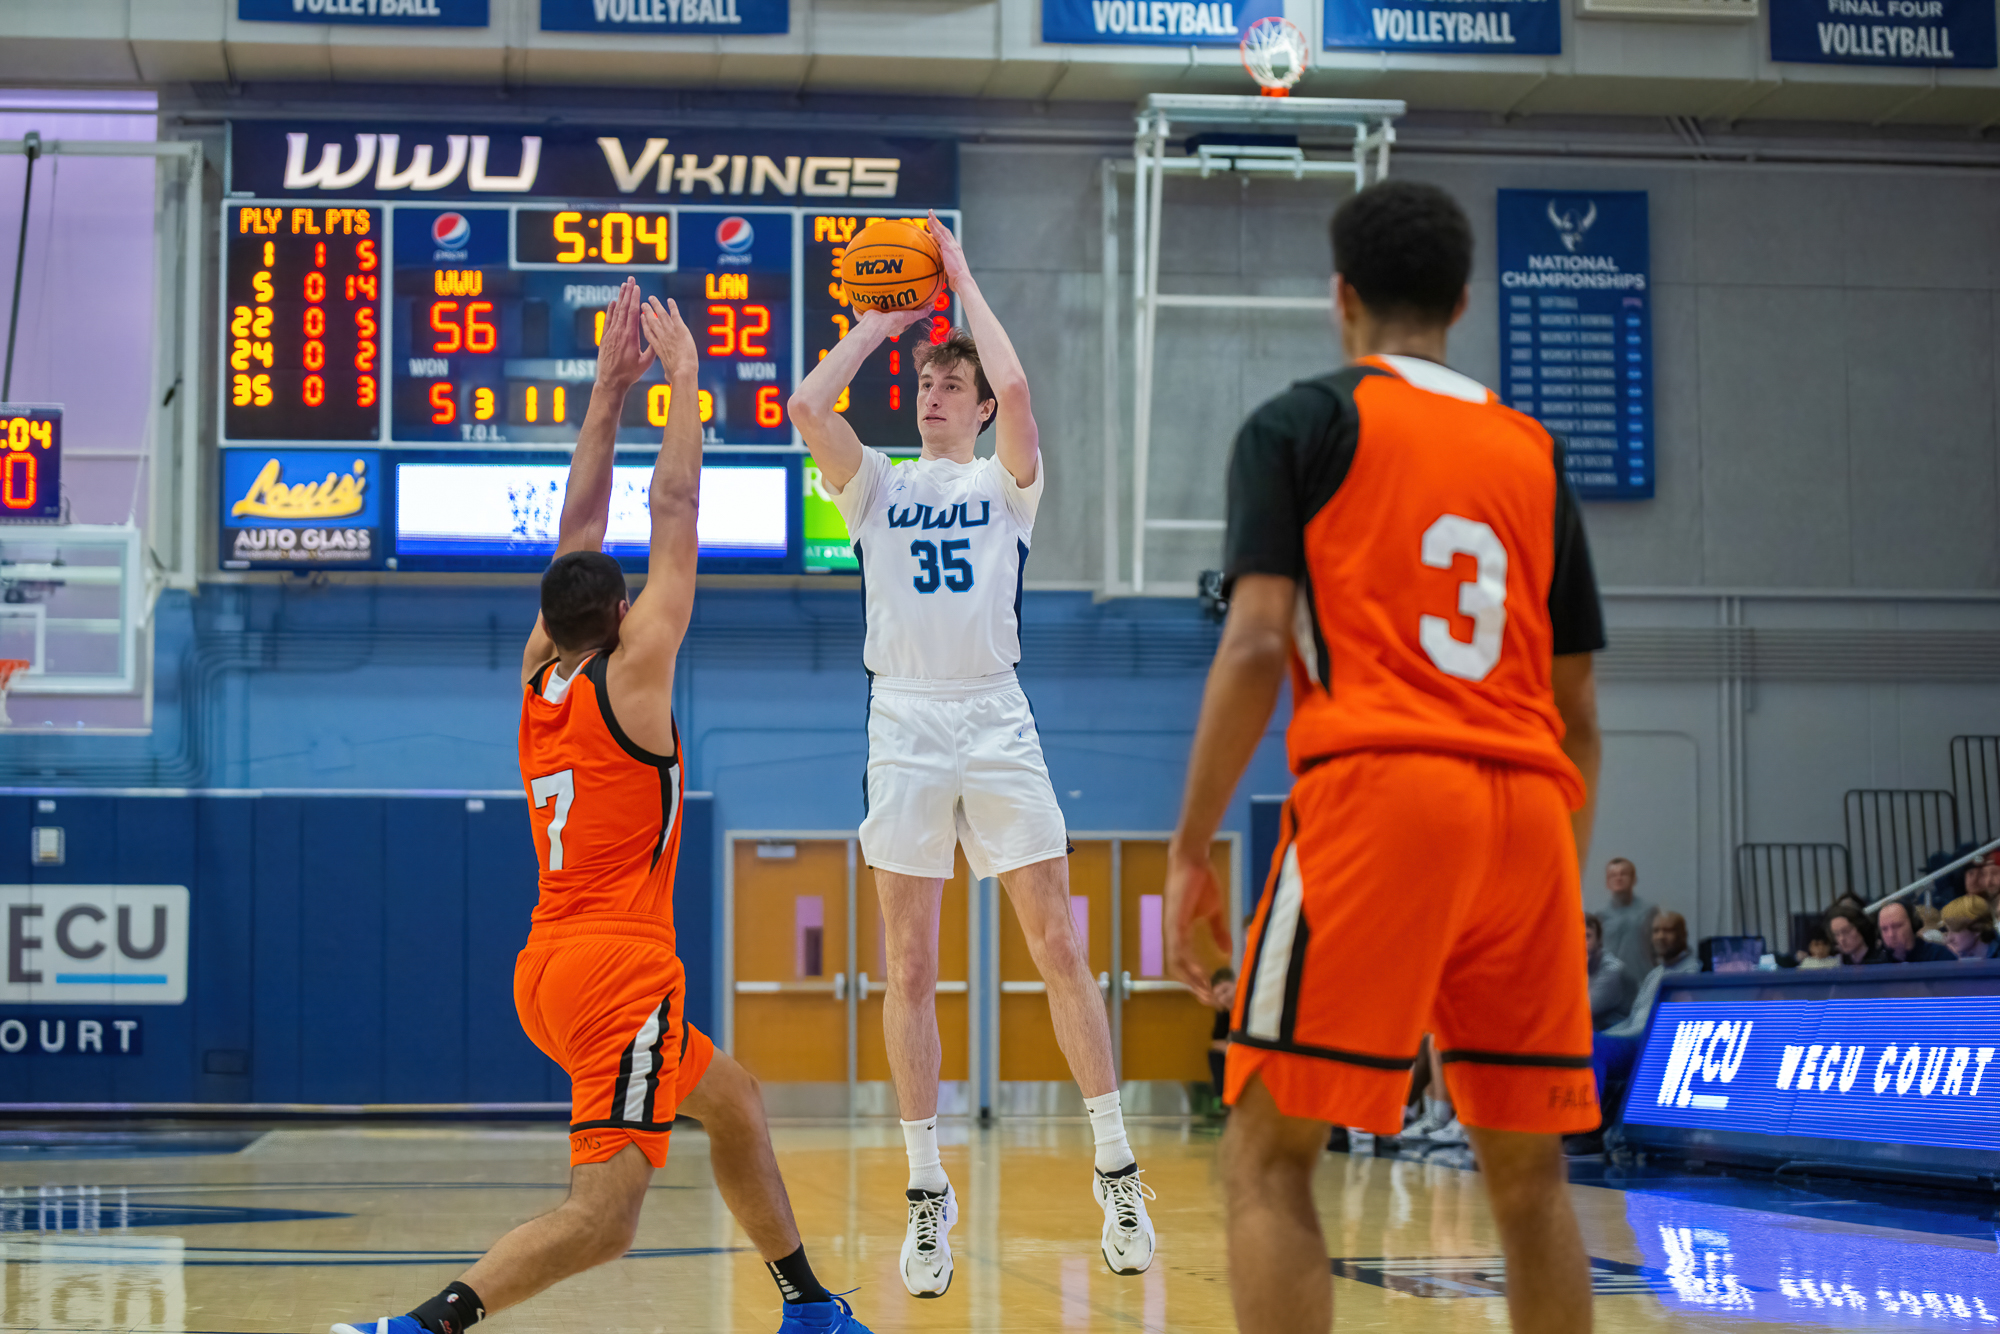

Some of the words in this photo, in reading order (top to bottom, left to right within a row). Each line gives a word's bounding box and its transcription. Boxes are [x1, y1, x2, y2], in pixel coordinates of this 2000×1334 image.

[593, 0, 741, 24] VOLLEYBALL
[1092, 0, 1239, 36] VOLLEYBALL
[1828, 0, 1885, 17] FINAL
[1888, 0, 1943, 18] FOUR
[1371, 8, 1516, 44] VOLLEYBALL
[1817, 22, 1954, 59] VOLLEYBALL
[284, 132, 542, 192] WWU
[597, 137, 900, 198] VIKINGS
[240, 208, 282, 234] PLY
[292, 208, 320, 234] FL
[325, 208, 371, 235] PTS
[553, 211, 667, 264] 5:04
[815, 216, 857, 243] PLY
[315, 241, 327, 268] 1
[356, 239, 378, 271] 5
[856, 259, 903, 276] NCAA
[1528, 254, 1619, 272] NATIONAL
[252, 271, 275, 303] 5
[303, 271, 326, 301] 0
[345, 274, 378, 301] 14
[435, 270, 483, 297] WWU
[564, 285, 621, 304] PERIOD
[706, 273, 748, 299] LAN
[1502, 271, 1646, 290] CHAMPIONSHIPS
[852, 288, 919, 310] Wilson
[231, 306, 274, 338] 22
[303, 306, 325, 338] 0
[355, 307, 377, 338] 5
[430, 301, 497, 354] 56
[707, 304, 770, 357] 32
[230, 339, 274, 371] 24
[303, 339, 325, 371] 0
[354, 339, 377, 372] 2
[409, 358, 449, 378] WON
[555, 359, 597, 379] LAST
[736, 362, 776, 381] WON
[232, 374, 274, 407] 35
[302, 374, 325, 407] 0
[356, 374, 377, 407] 3
[428, 382, 456, 425] 5
[474, 387, 495, 420] 3
[525, 386, 566, 423] 11
[756, 386, 783, 428] 6
[460, 423, 506, 441] T.O.L.
[0, 451, 37, 509] 0
[888, 500, 990, 530] WWU
[234, 528, 297, 550] AUTO
[301, 528, 371, 551] GLASS
[910, 538, 974, 594] 35
[1419, 513, 1508, 682] 3
[530, 768, 575, 871] 7
[8, 902, 168, 983] ECU
[0, 1019, 138, 1053] OURT
[1776, 1044, 1866, 1093] WECU
[1874, 1045, 1996, 1096] COURT
